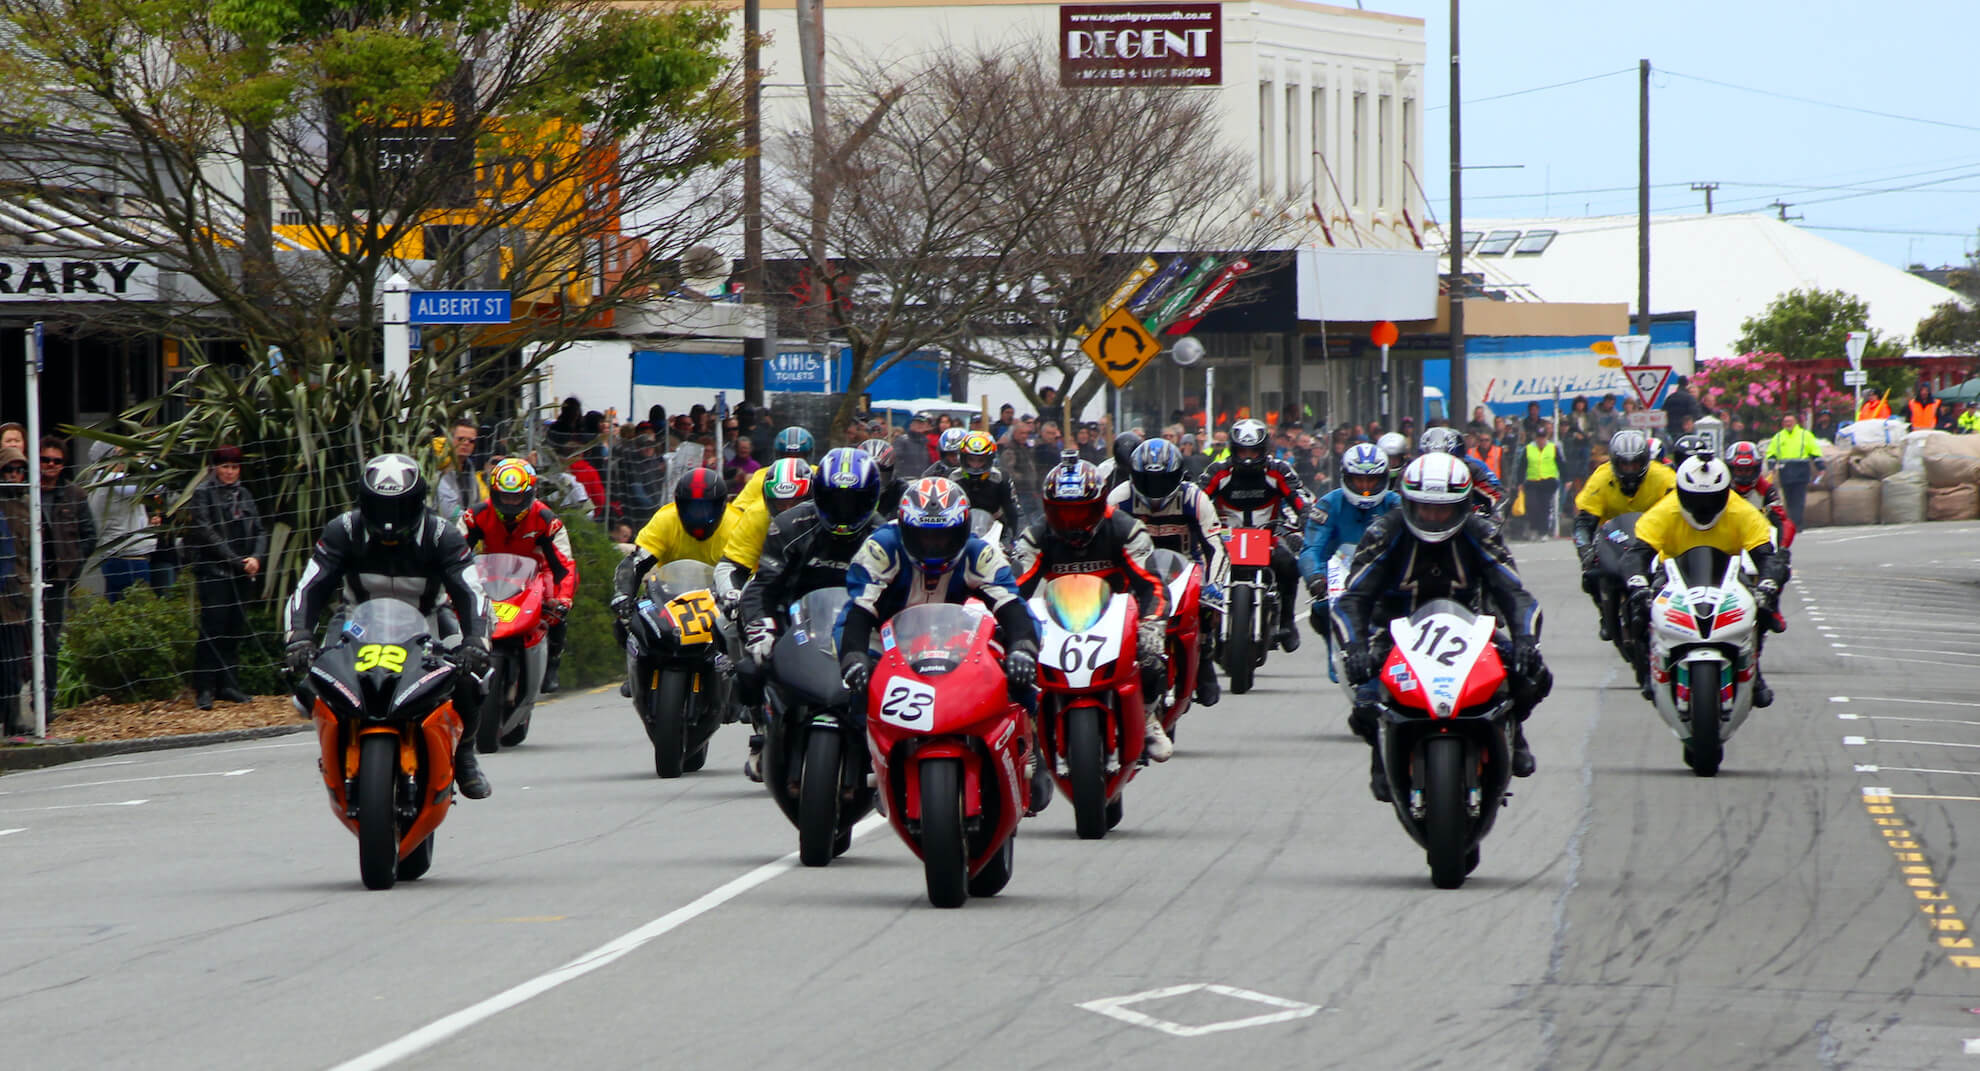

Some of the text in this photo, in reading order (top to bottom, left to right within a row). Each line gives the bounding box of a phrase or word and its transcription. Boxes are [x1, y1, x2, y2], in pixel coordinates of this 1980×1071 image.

[1068, 29, 1213, 59] REGENT
[417, 298, 504, 315] ALBERT ST
[775, 371, 816, 381] TOILETS
[671, 597, 716, 636] 25
[354, 643, 408, 673] 32
[1059, 634, 1108, 674] 67
[1411, 619, 1468, 667] 112
[881, 686, 934, 722] 23
